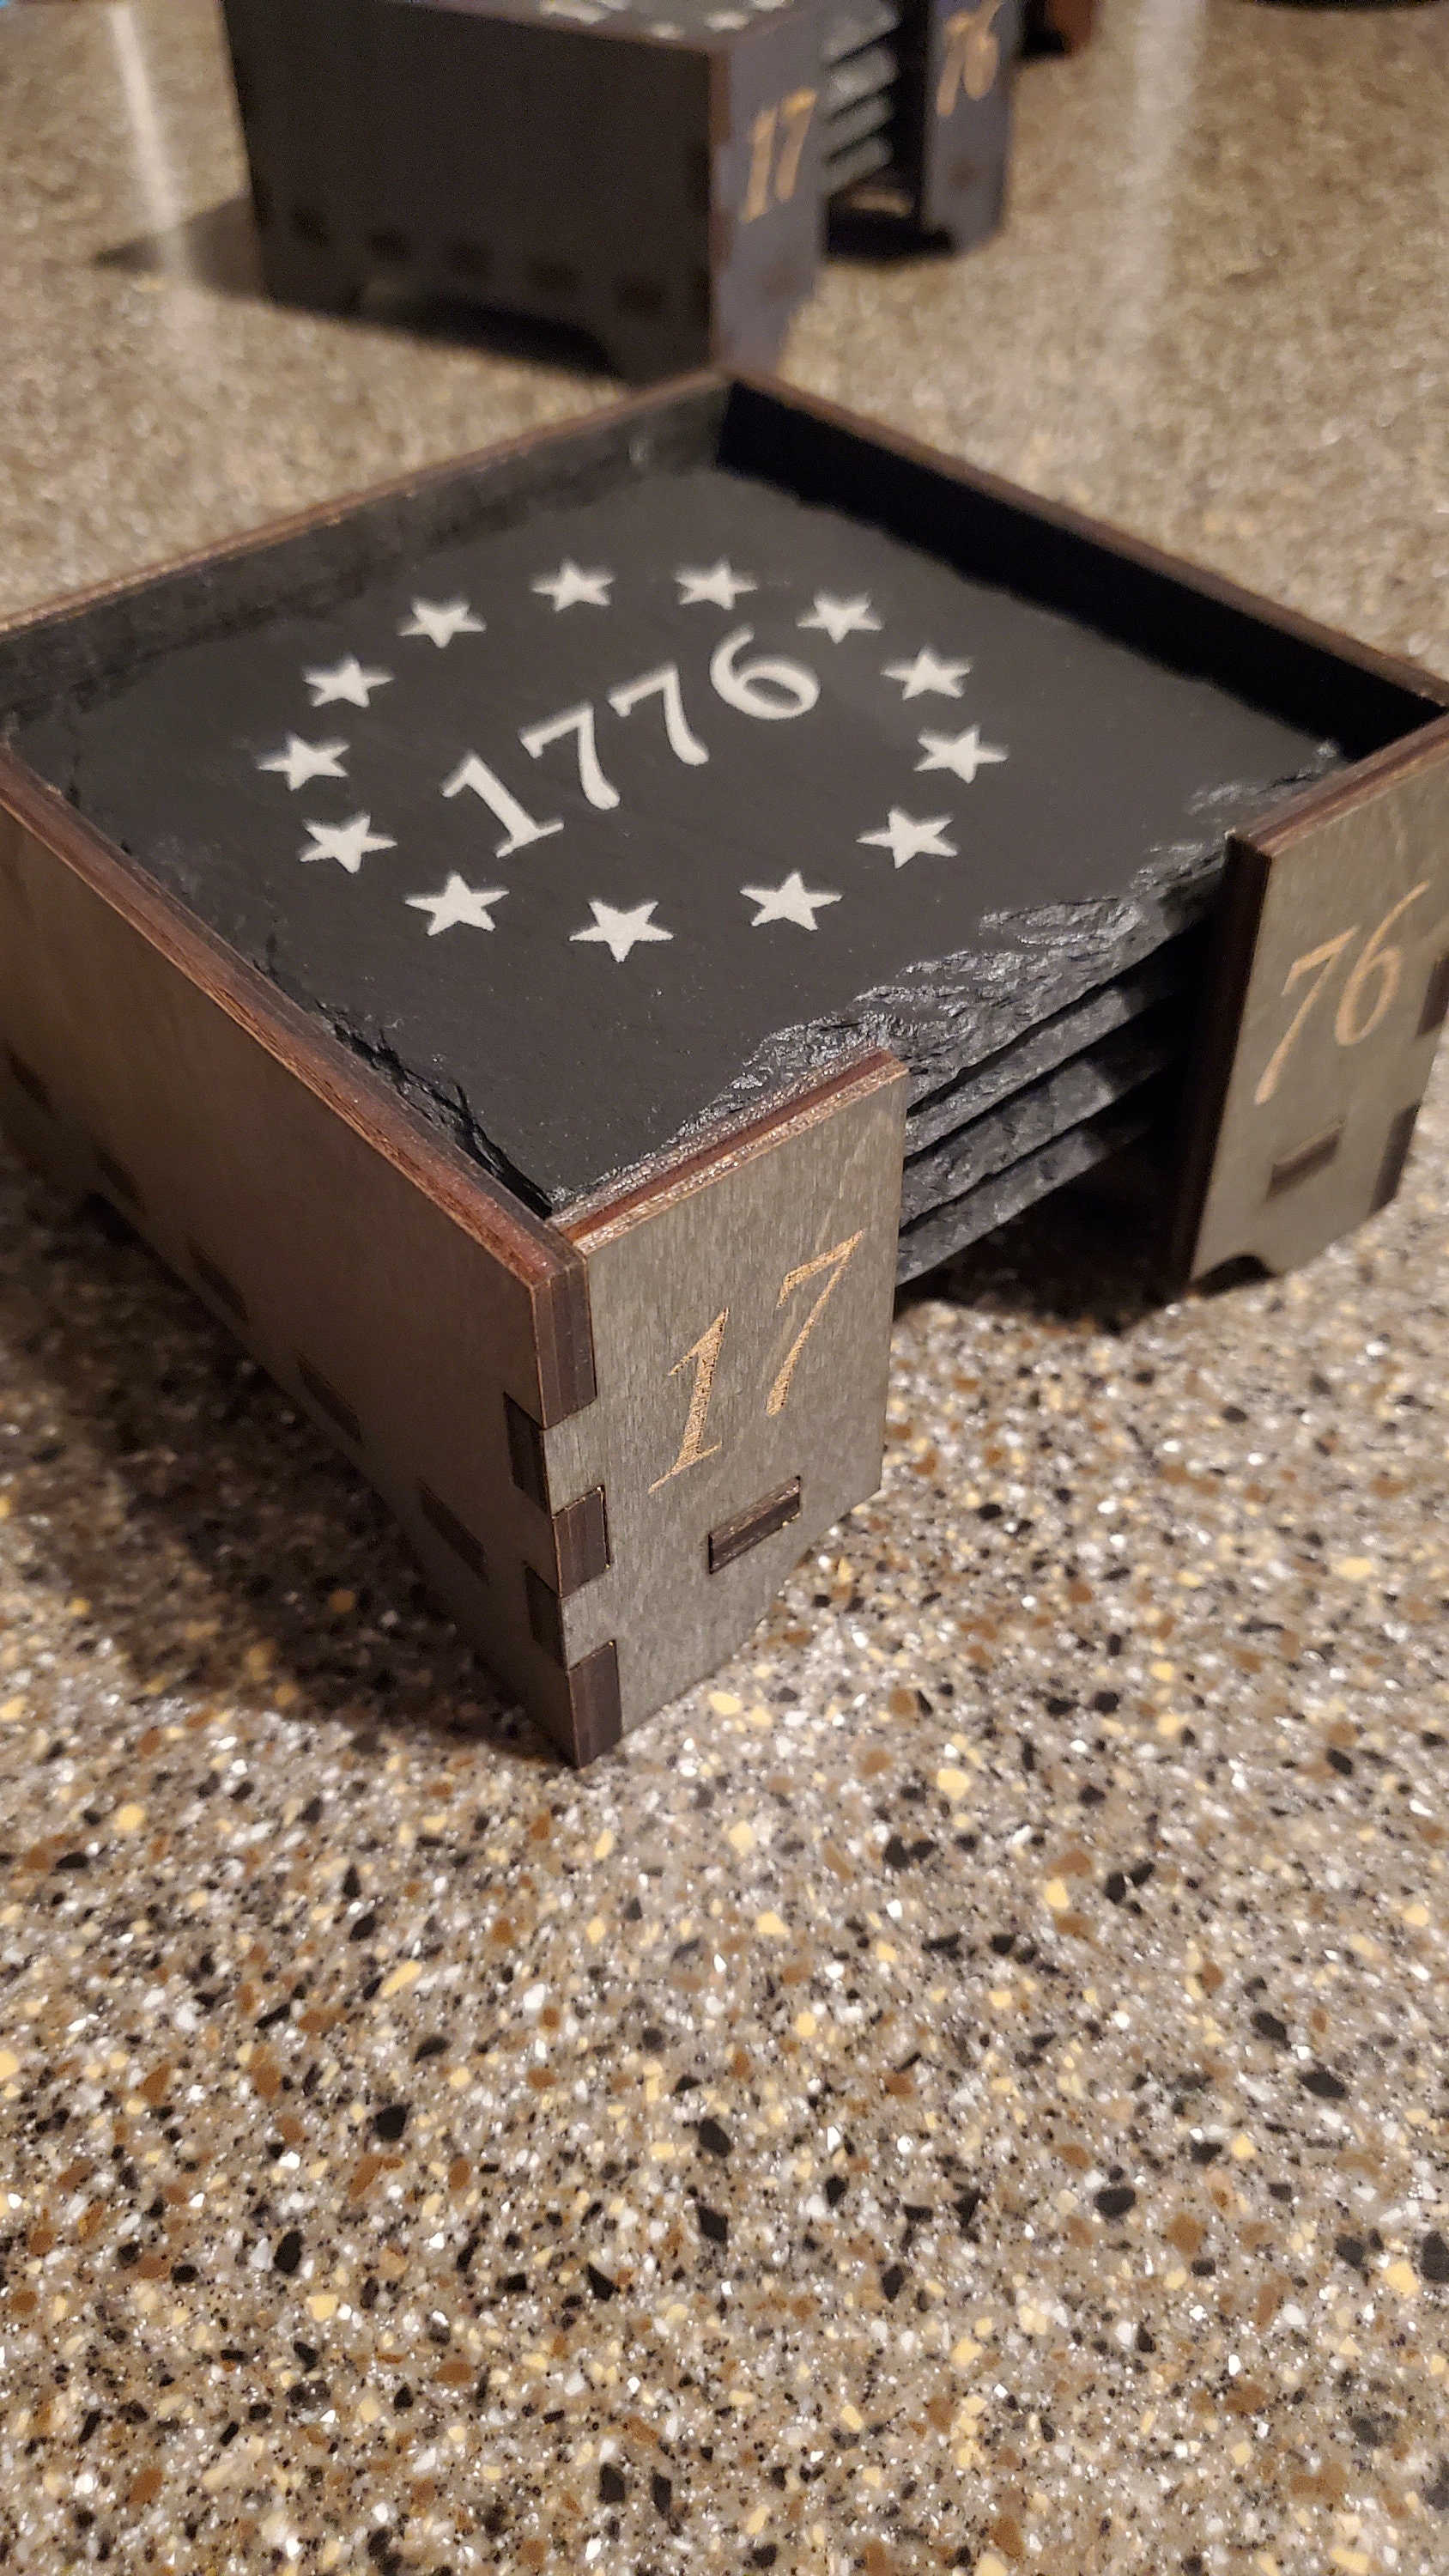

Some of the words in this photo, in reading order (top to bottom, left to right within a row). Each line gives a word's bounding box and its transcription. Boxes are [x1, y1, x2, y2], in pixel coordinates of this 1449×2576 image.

[740, 88, 818, 222] 17
[937, 0, 1002, 117] 76
[440, 622, 821, 859] 1776
[1254, 879, 1432, 1106] 76
[647, 1229, 864, 1495] 17
